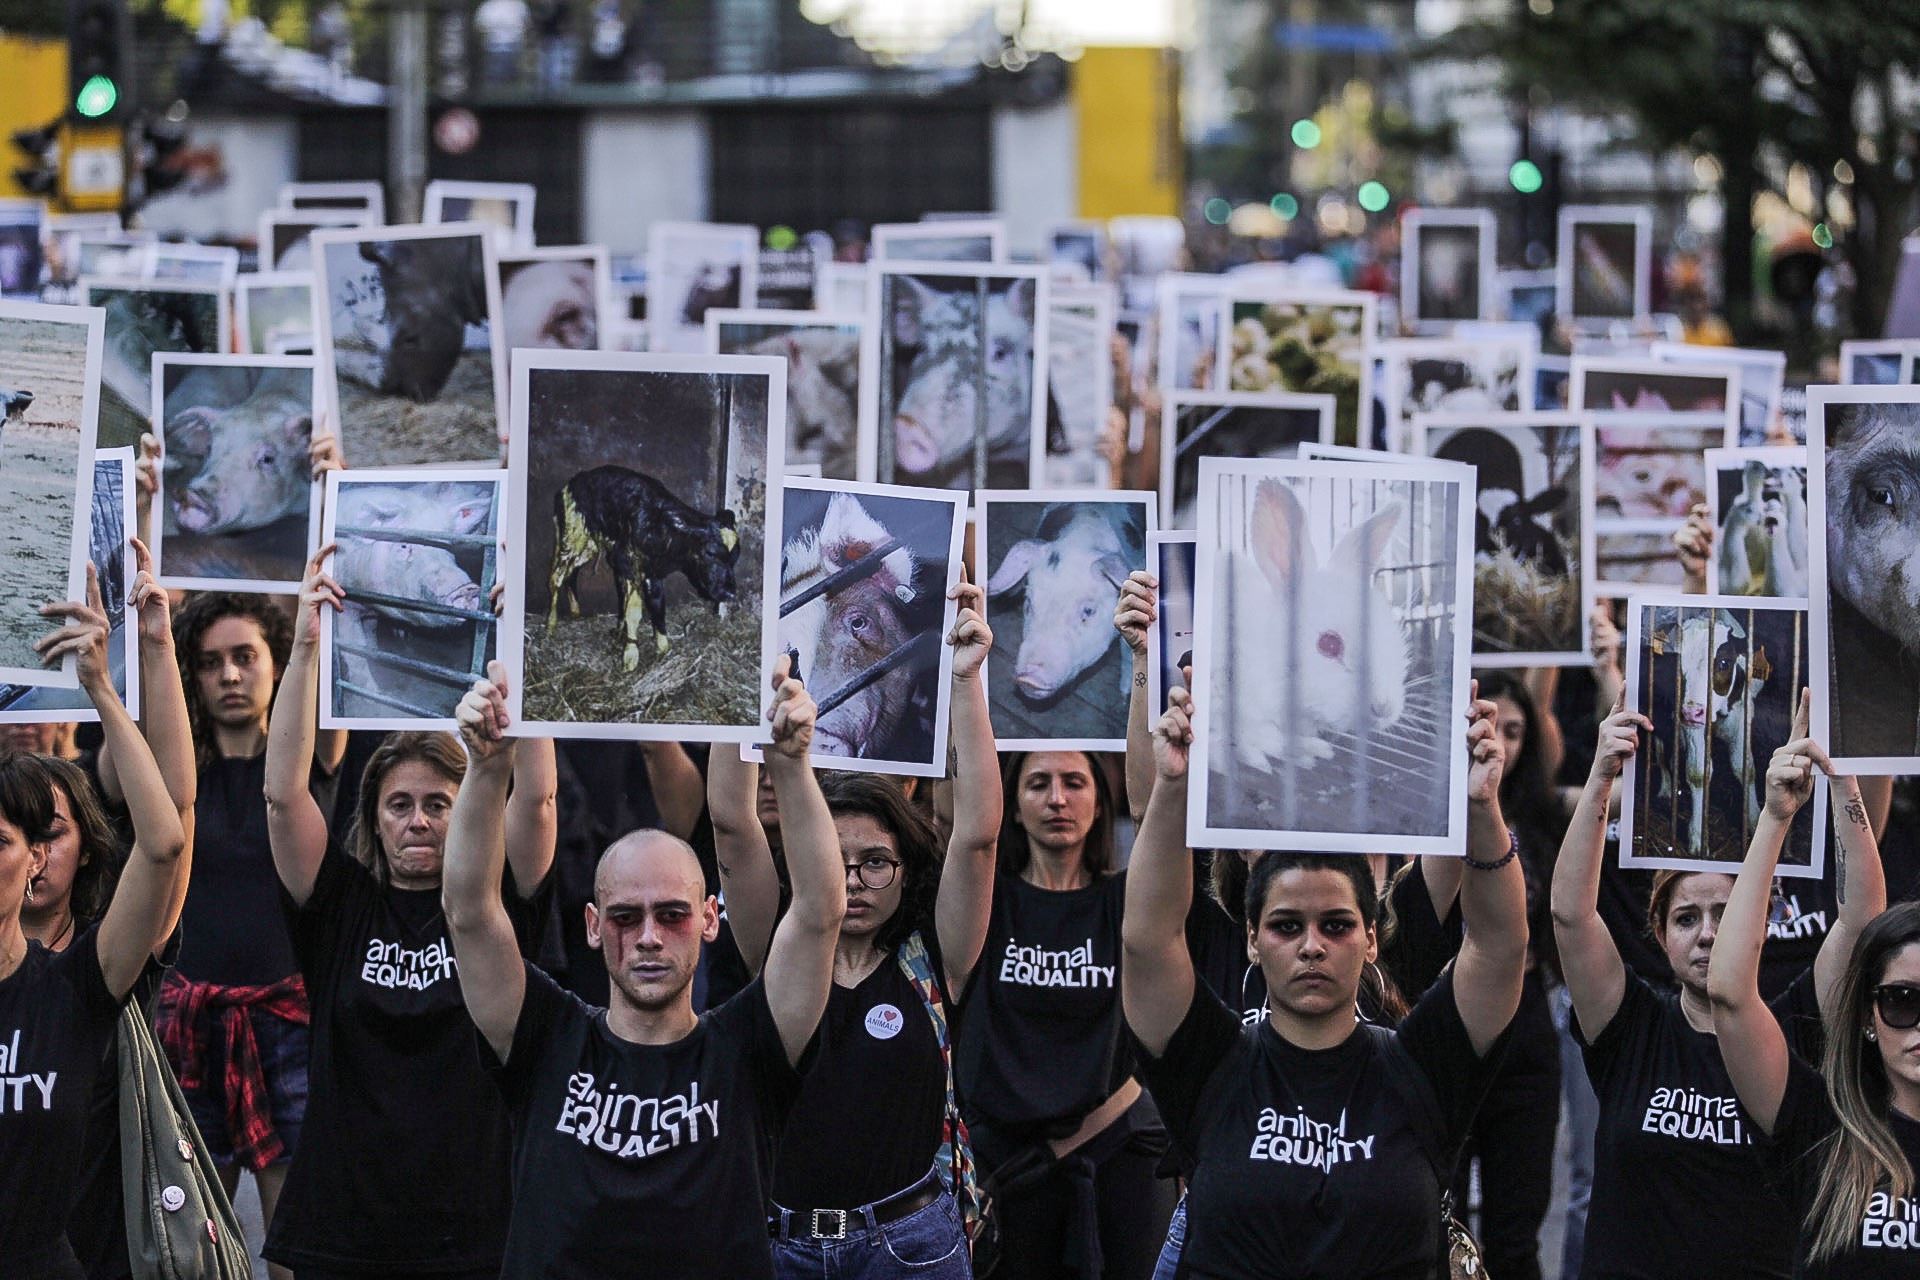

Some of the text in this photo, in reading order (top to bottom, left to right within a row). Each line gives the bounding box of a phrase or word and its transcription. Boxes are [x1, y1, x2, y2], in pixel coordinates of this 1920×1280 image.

[1005, 937, 1093, 969] animal
[361, 956, 460, 991] EQUALIT
[999, 959, 1115, 988] EQUALITY
[866, 1017, 900, 1033] ANIMALS
[568, 1072, 698, 1132] animal
[556, 1097, 719, 1158] EQUALITY
[1641, 1107, 1752, 1145] EQUALI
